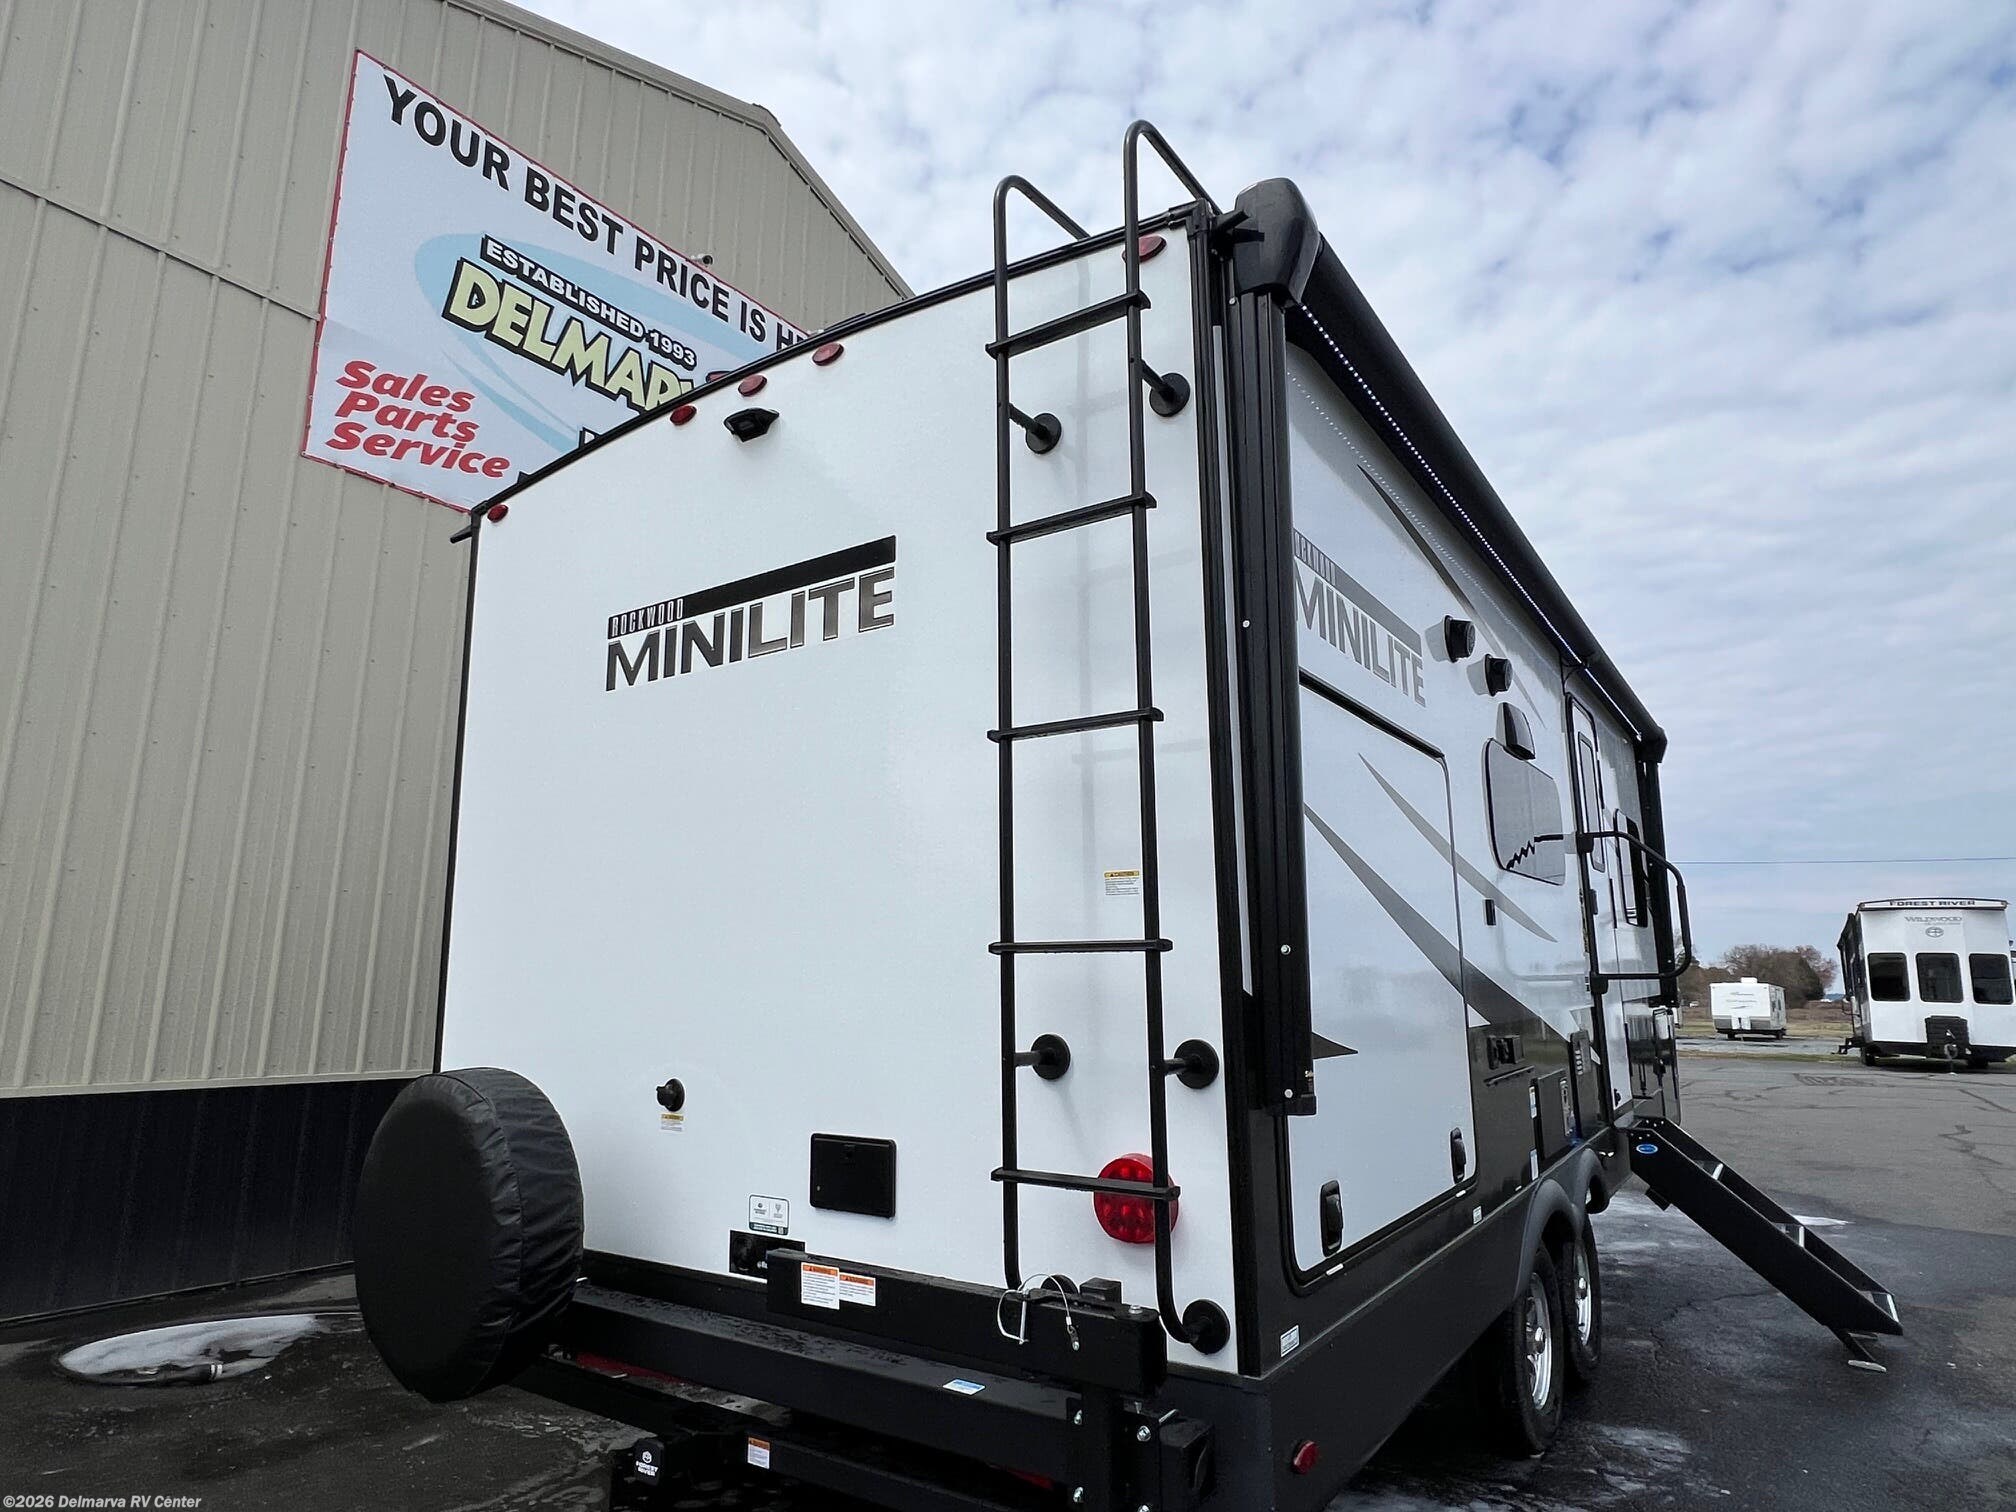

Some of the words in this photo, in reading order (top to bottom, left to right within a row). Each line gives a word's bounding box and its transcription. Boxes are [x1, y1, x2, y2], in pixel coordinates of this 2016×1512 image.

[383, 75, 510, 191] YOUR
[524, 165, 624, 255] BEST
[635, 236, 730, 323] PRICE
[740, 300, 766, 342] IS
[777, 322, 805, 352] H
[486, 238, 644, 338] ESTABLISHED
[651, 331, 696, 367] 1993
[335, 391, 479, 442] Parts
[336, 361, 475, 412] Sales
[325, 422, 510, 478] Service
[606, 566, 895, 692] MINILITE
[611, 598, 684, 638] ROCKWOOD
[1294, 560, 1426, 707] MINILITE
